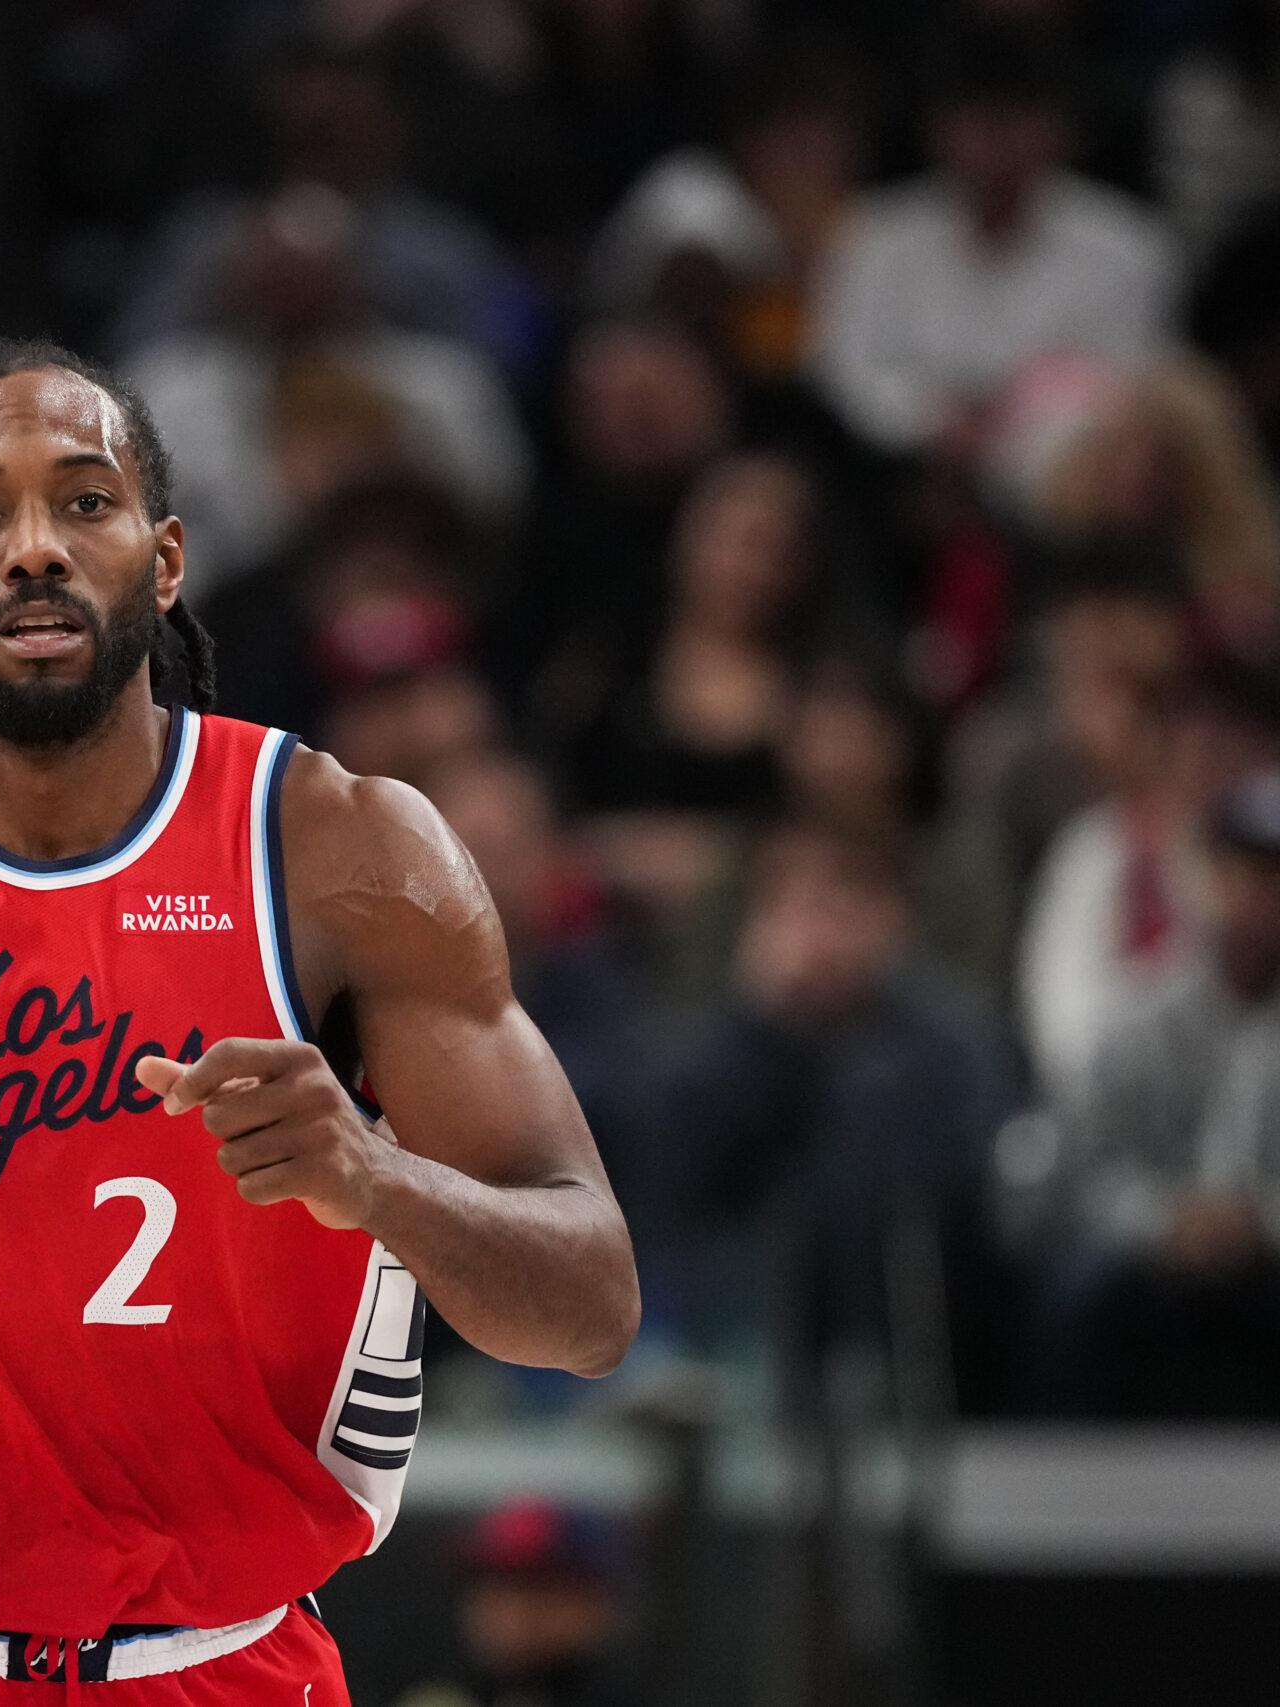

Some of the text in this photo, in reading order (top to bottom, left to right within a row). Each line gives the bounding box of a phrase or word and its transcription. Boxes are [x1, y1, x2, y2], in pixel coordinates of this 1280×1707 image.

[145, 895, 211, 912] VISIT
[122, 913, 234, 931] RWANDA
[82, 1175, 178, 1326] 2
